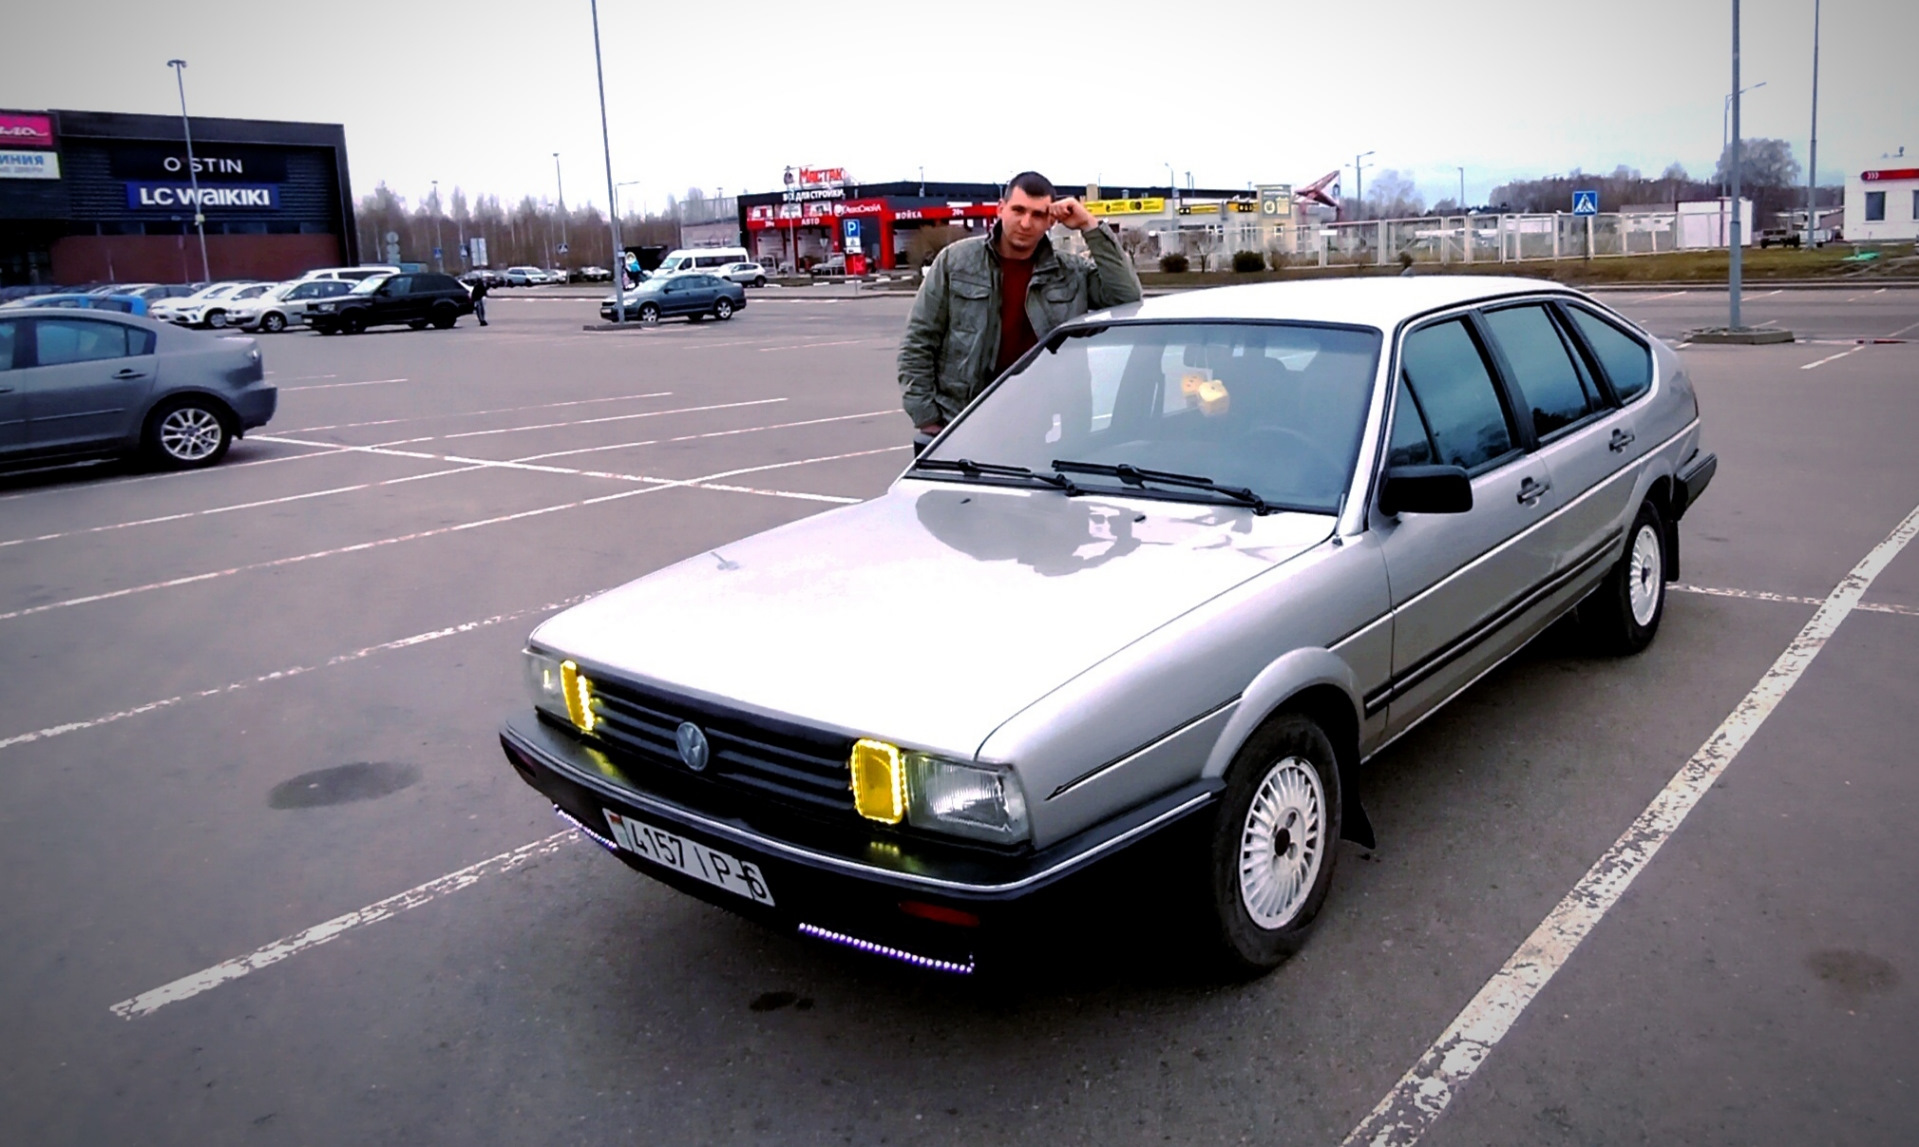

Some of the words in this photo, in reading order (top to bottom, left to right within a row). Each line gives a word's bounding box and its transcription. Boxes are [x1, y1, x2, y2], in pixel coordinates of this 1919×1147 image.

[139, 187, 174, 205] LC
[801, 217, 820, 227] АВТО
[895, 209, 922, 220] МОЙКА
[847, 221, 857, 236] P
[629, 822, 685, 869] 4157
